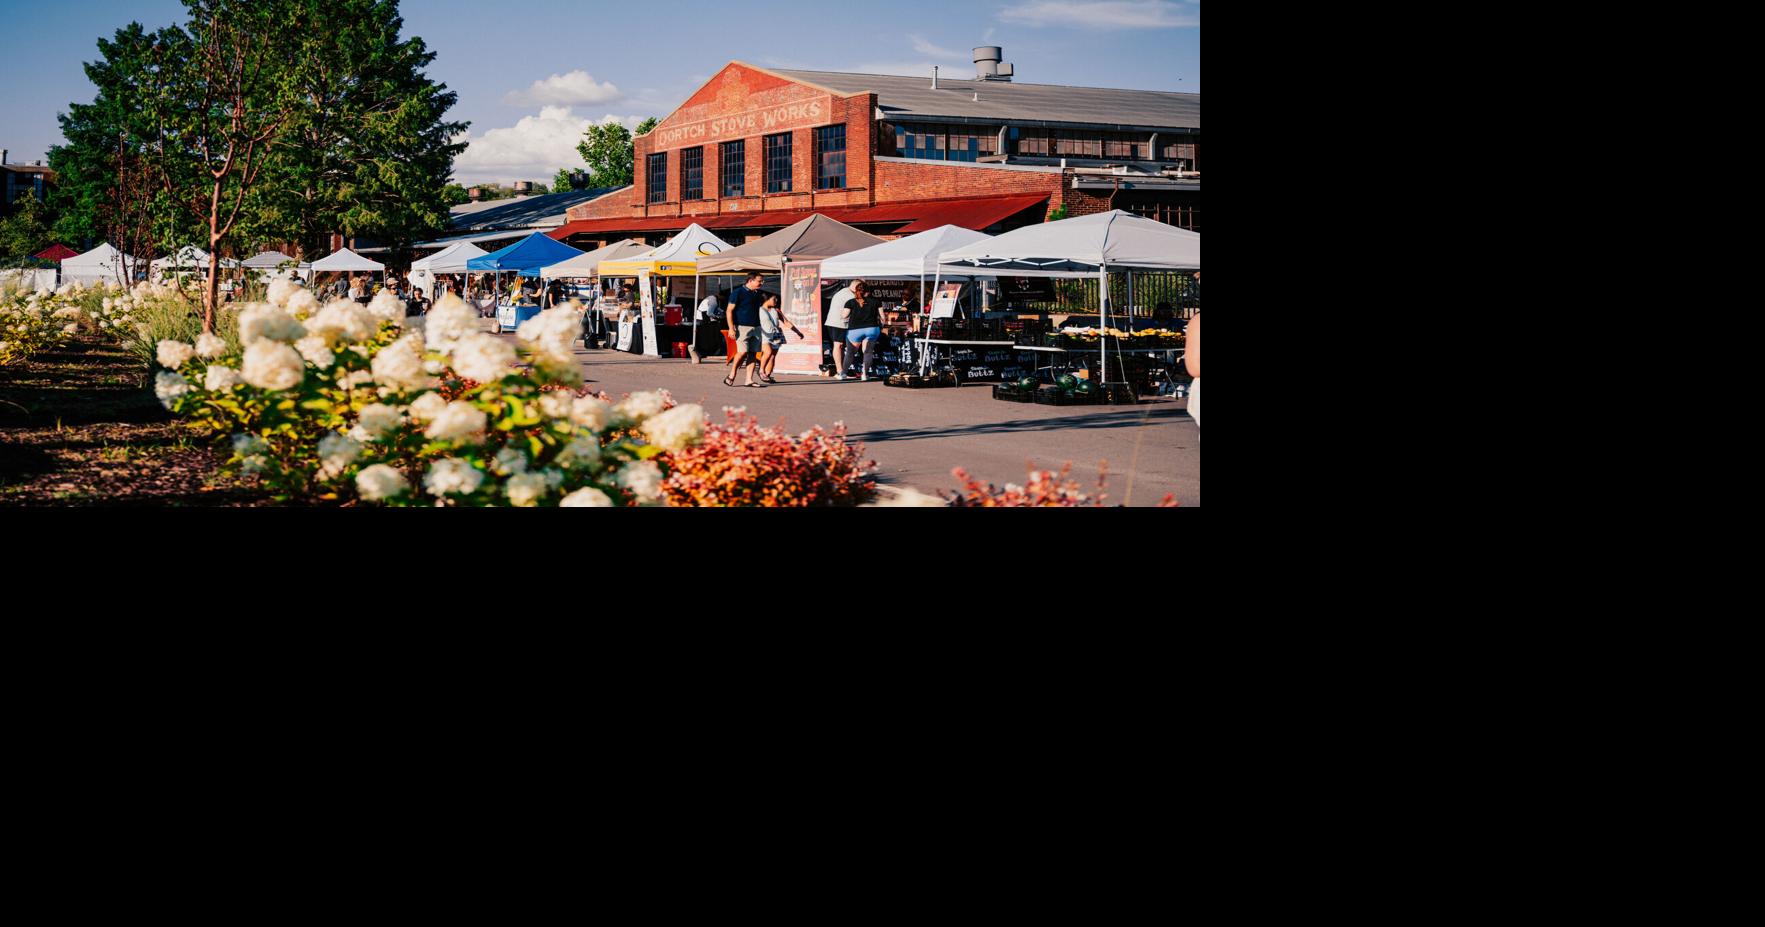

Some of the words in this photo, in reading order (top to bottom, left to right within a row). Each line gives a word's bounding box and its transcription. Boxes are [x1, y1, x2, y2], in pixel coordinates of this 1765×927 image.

[659, 122, 705, 146] DORTCH
[711, 113, 756, 138] STOVE
[762, 101, 821, 129] WORKS
